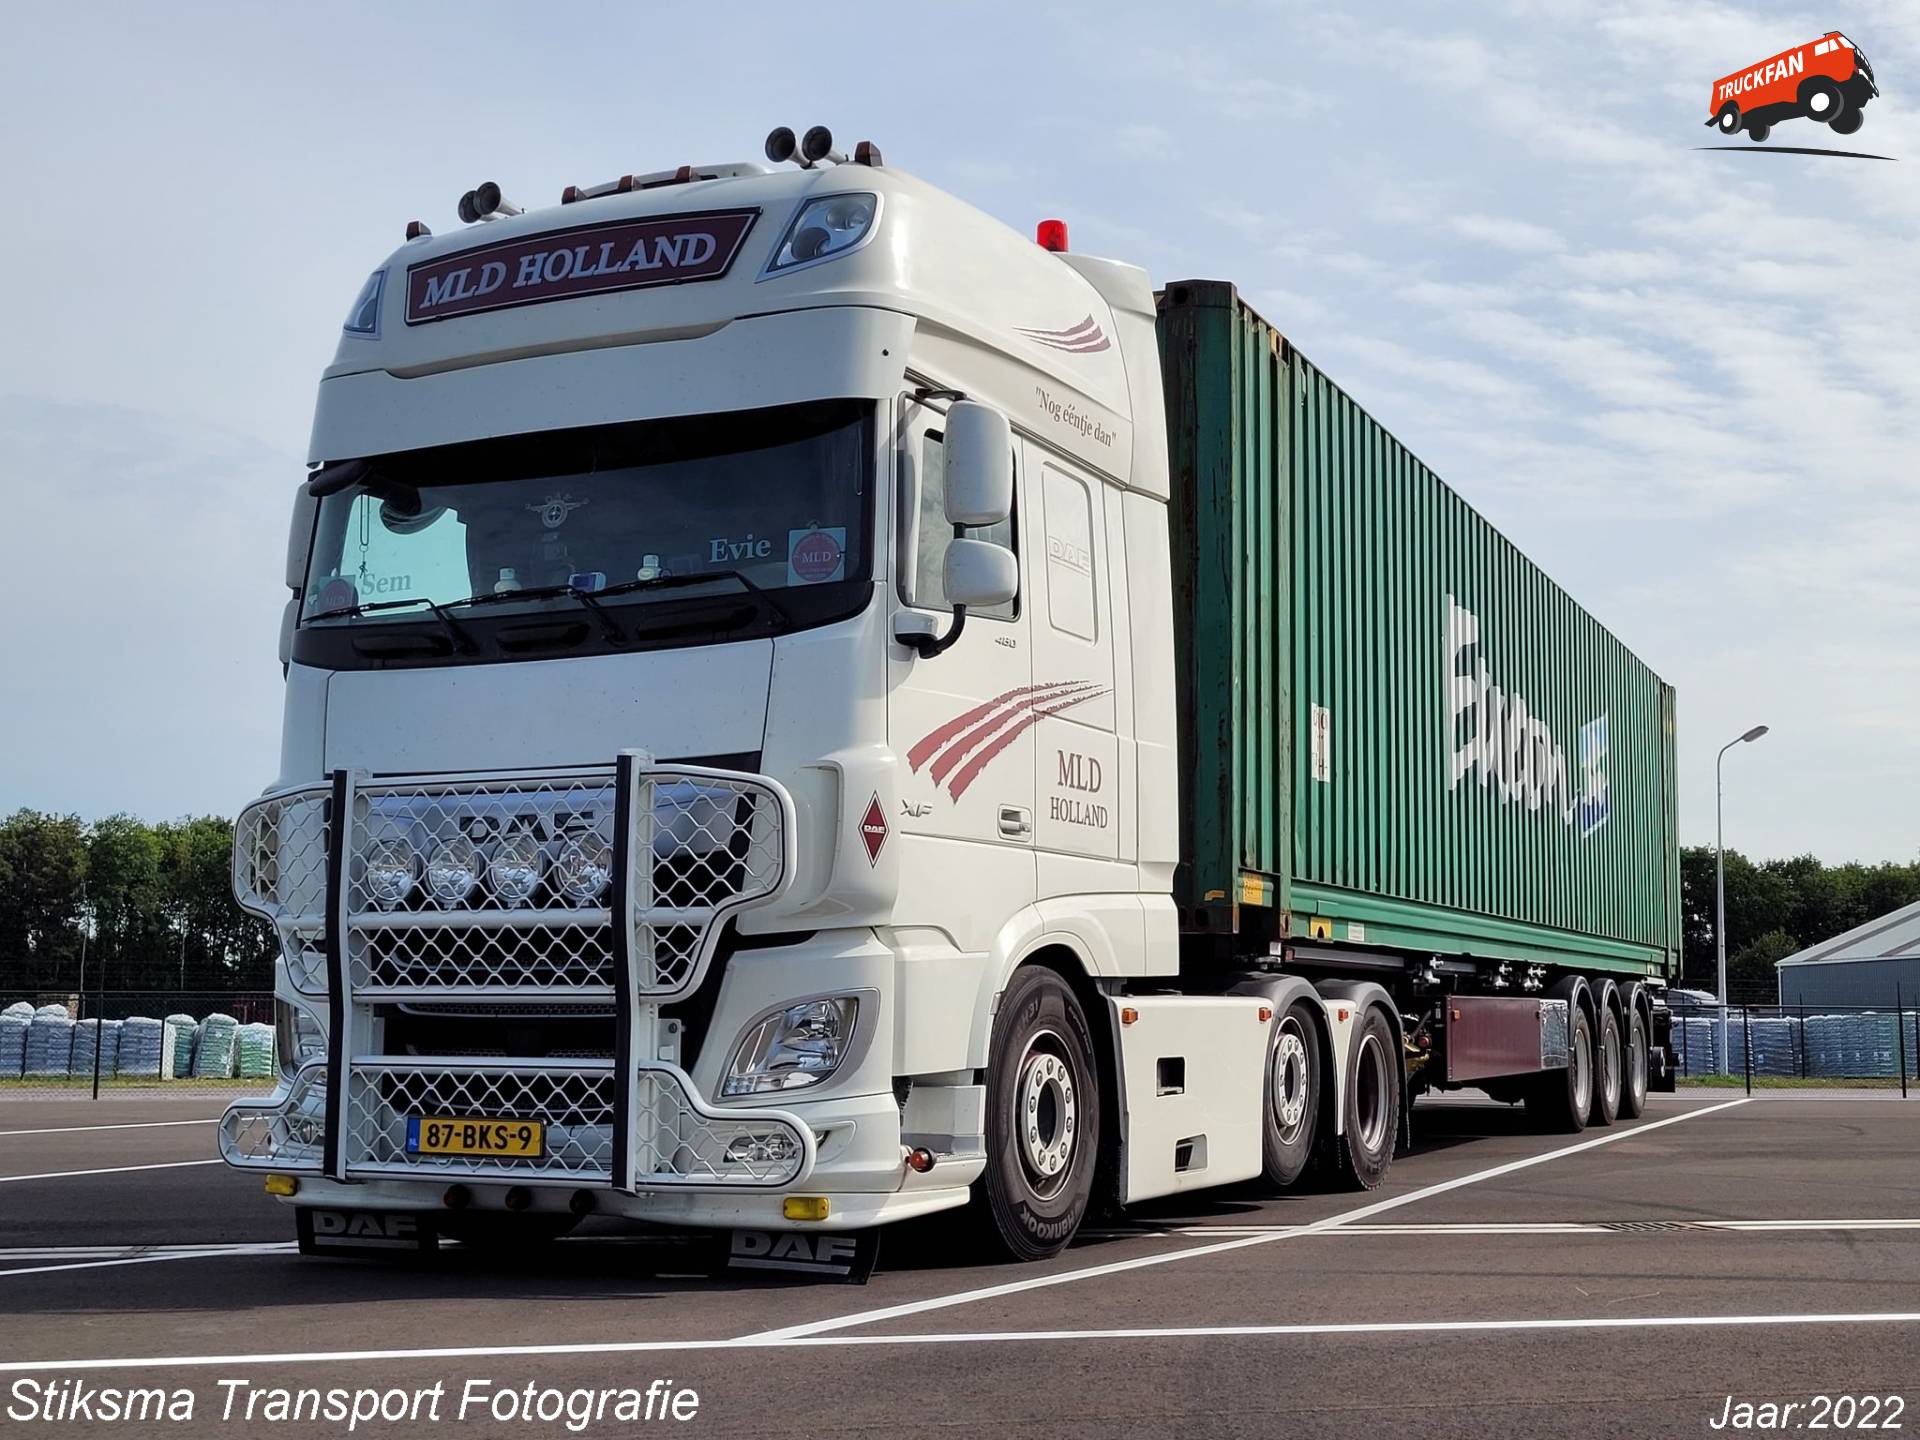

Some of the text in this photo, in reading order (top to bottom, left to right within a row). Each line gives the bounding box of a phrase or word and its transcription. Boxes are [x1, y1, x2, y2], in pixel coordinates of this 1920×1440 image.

[418, 232, 717, 309] MLD HOLLAND
[1035, 386, 1062, 422] "Nog
[1094, 422, 1117, 447] dan"
[709, 533, 771, 563] Evie
[800, 551, 832, 564] MLD
[360, 573, 412, 595] Sem
[1057, 750, 1102, 793] MLD
[901, 799, 934, 818] XF
[1050, 797, 1108, 829] HOLLAND
[459, 810, 595, 843] DAF
[863, 824, 886, 834] DAF
[426, 1123, 533, 1151] 87-BKS-9
[312, 1211, 418, 1237] DAF
[730, 1230, 857, 1262] DAF
